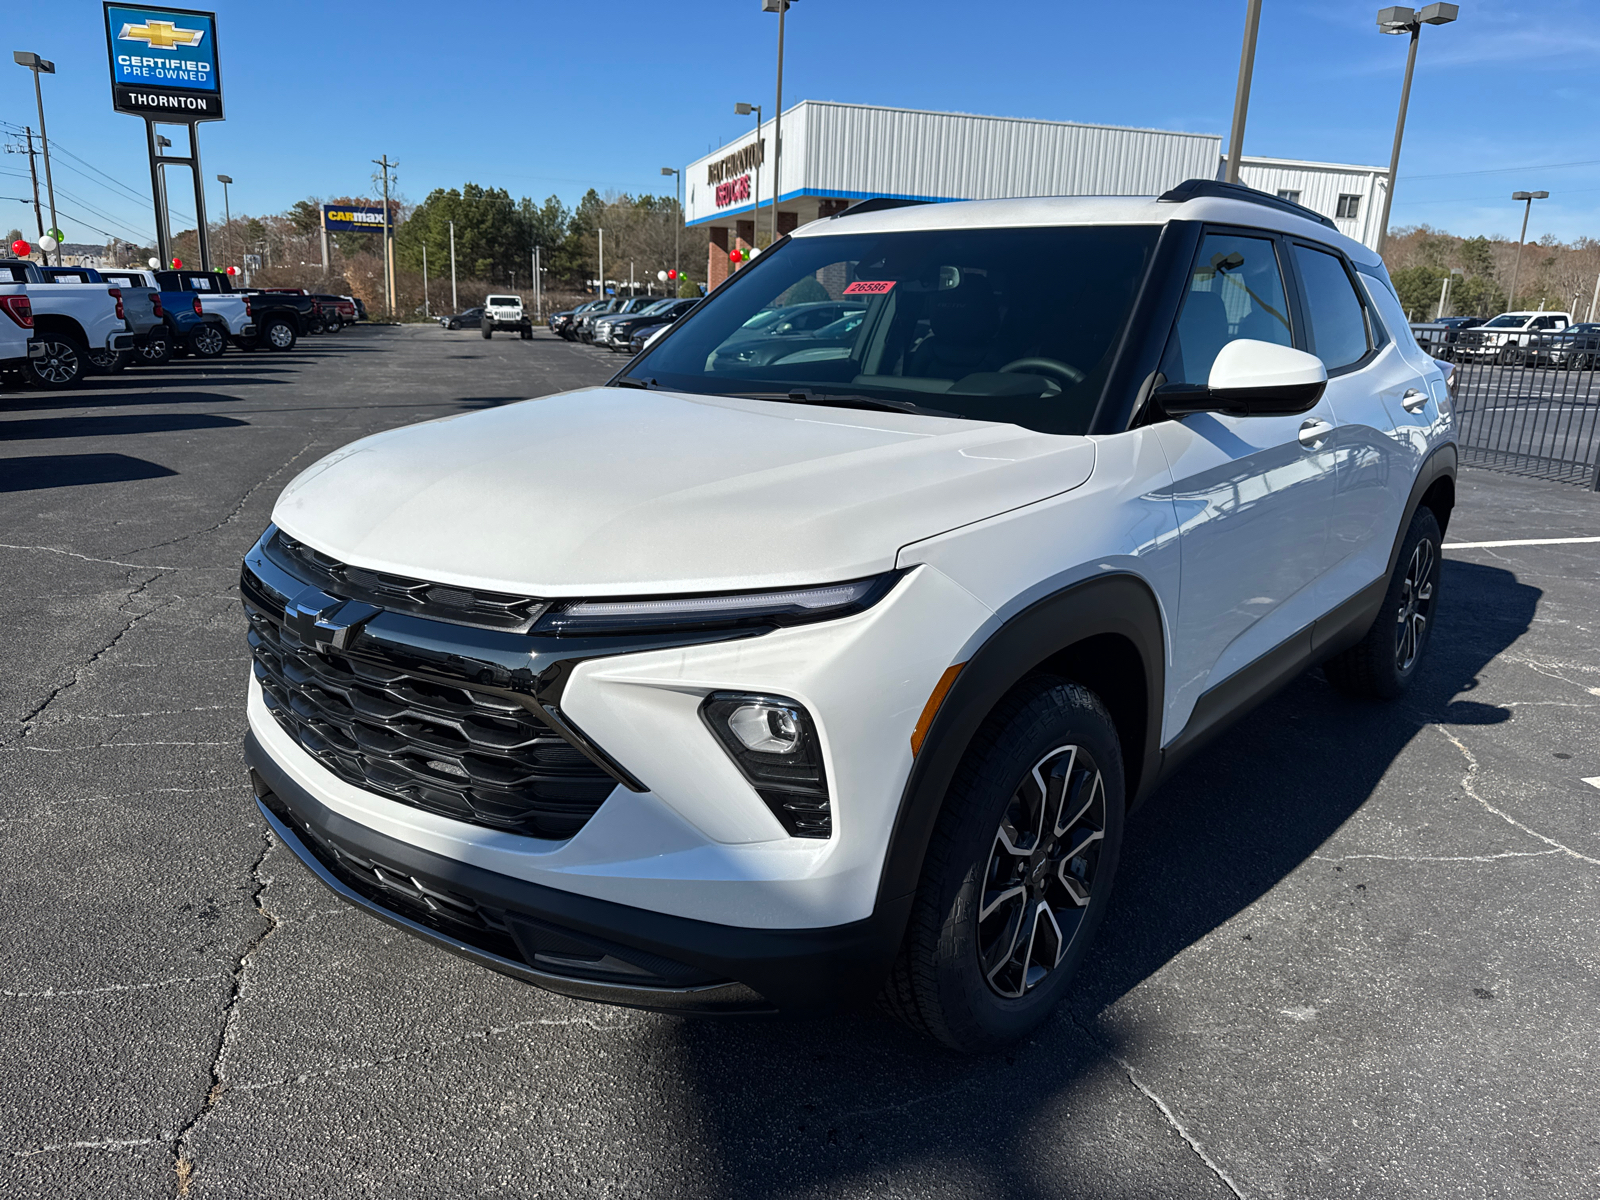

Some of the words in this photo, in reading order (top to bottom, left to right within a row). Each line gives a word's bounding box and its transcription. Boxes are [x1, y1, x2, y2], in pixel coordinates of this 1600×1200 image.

[118, 55, 210, 72] CERTIFIED
[123, 66, 207, 81] PRE-OWNED
[128, 93, 207, 110] THORNTON
[715, 181, 732, 208] USED
[731, 174, 751, 203] CARS
[849, 283, 888, 292] 26586
